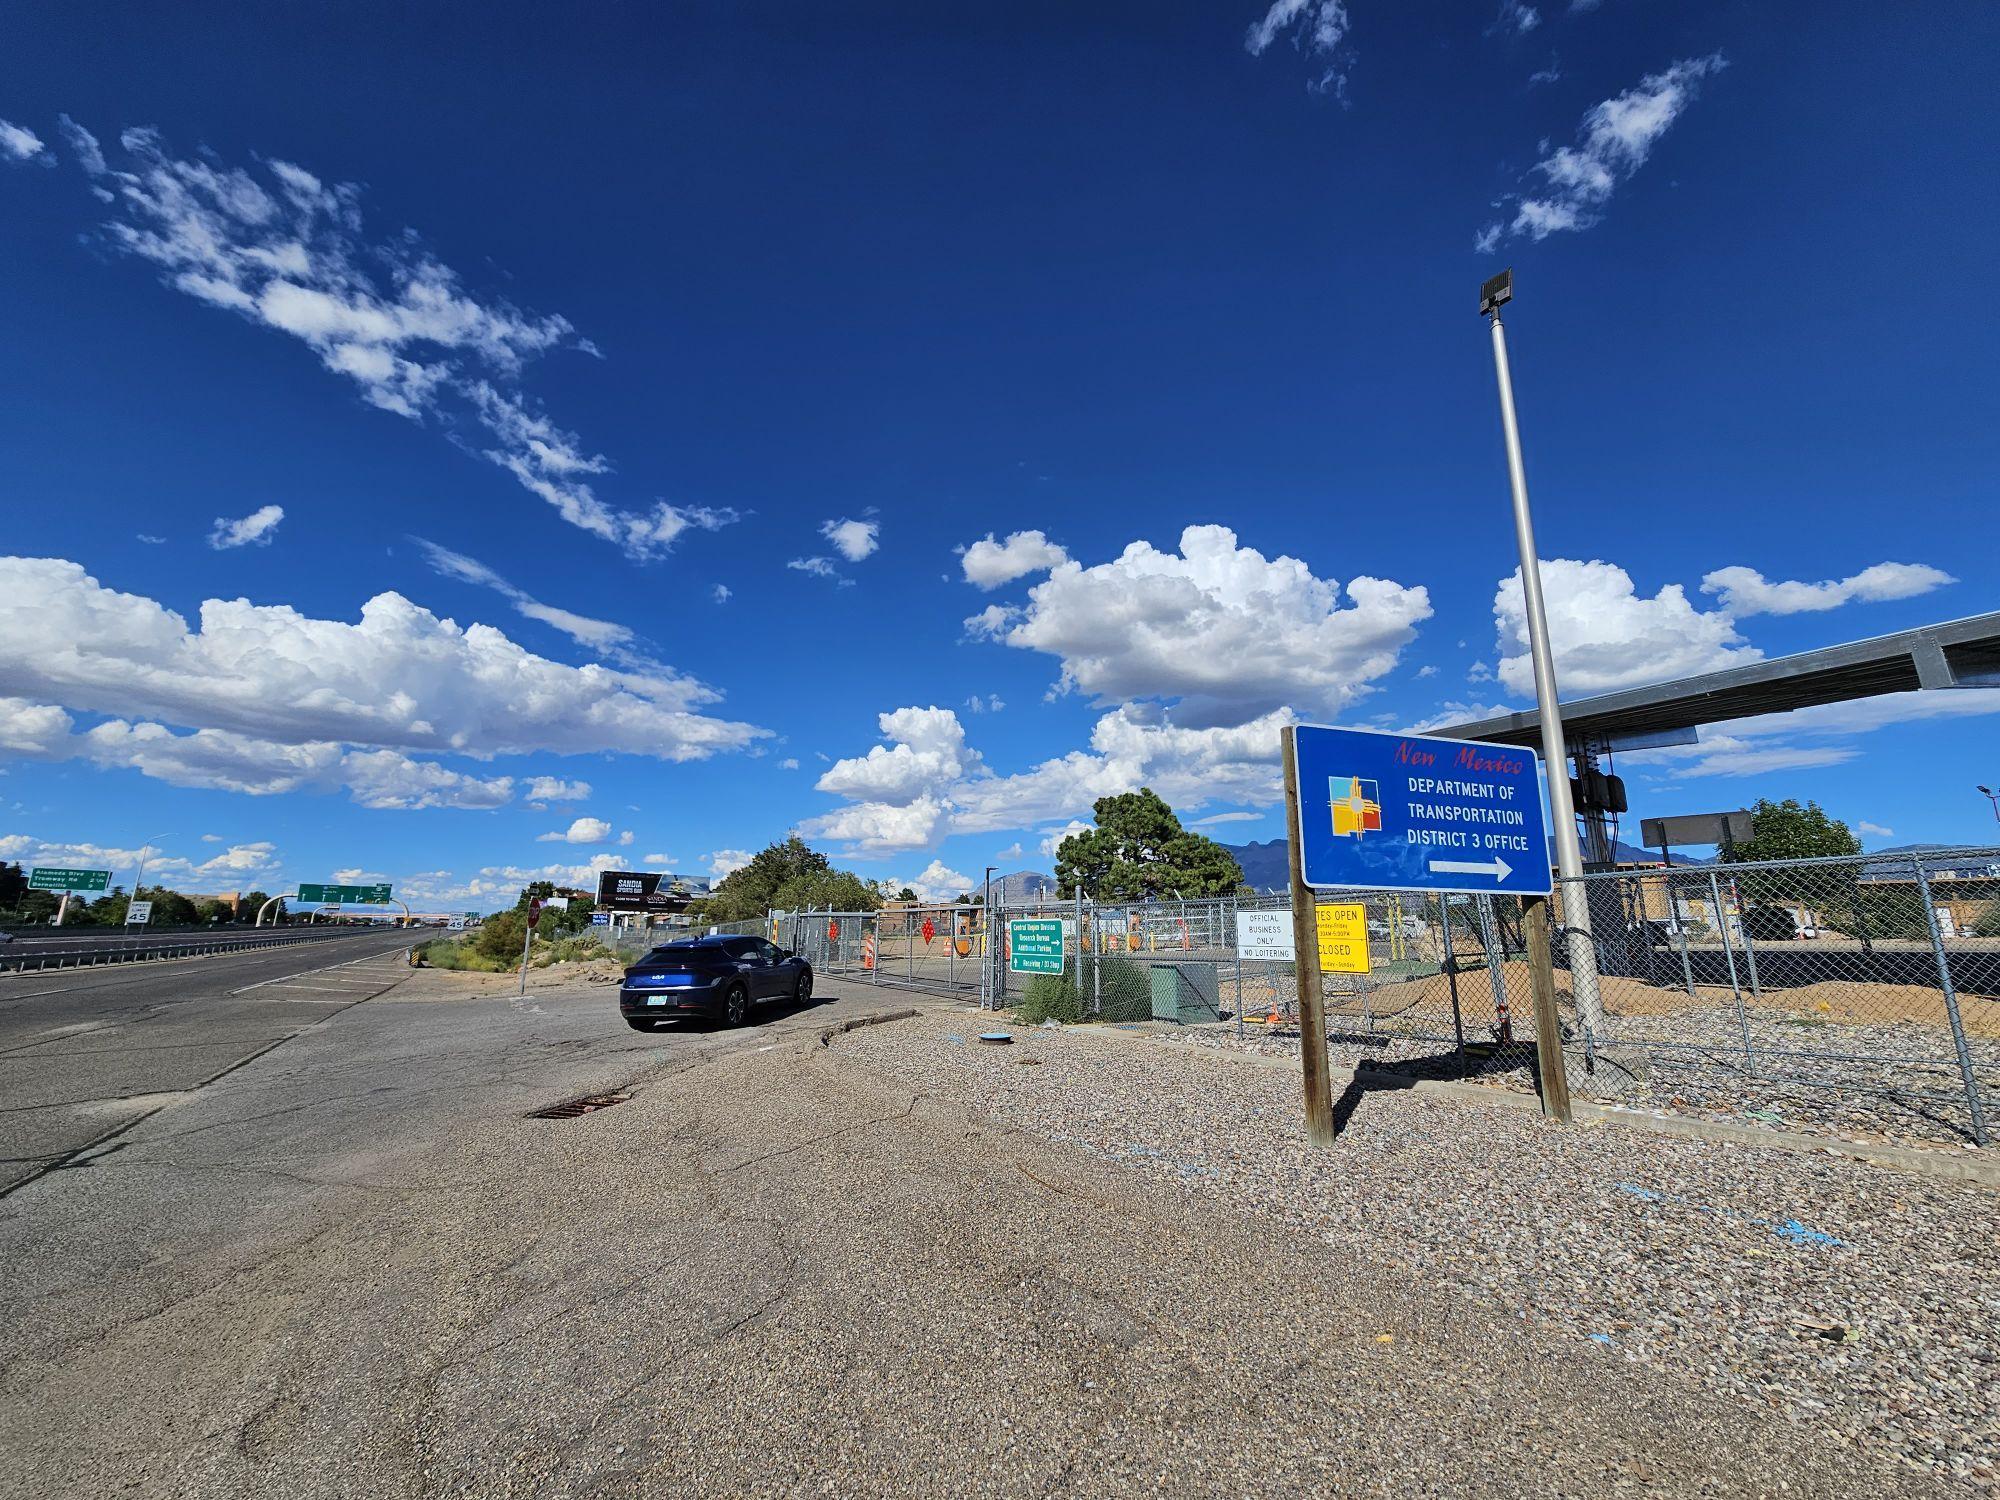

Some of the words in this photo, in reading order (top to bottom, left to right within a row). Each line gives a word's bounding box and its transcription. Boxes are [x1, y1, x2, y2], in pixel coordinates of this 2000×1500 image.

[1392, 740, 1436, 768] New
[1454, 746, 1523, 775] Mexico
[1408, 777, 1494, 799] DEPARTMENT
[1499, 785, 1515, 800] OF
[1407, 803, 1524, 826] TRANSPORTATION
[1407, 829, 1467, 847] DISTRICT
[1472, 833, 1480, 848] 3
[1484, 834, 1529, 851] OFFICE
[617, 879, 642, 888] SANDIA
[129, 913, 146, 921] 45
[1249, 914, 1279, 922] OFFICIAL
[1316, 910, 1331, 921] TES
[1335, 910, 1358, 921] OPEN
[1027, 924, 1039, 932] Region
[1248, 925, 1282, 934] BUSINESS
[1256, 937, 1274, 945] ONLY
[1037, 944, 1051, 954] Parking
[1244, 949, 1253, 957] NO
[1255, 949, 1290, 958] LOITERING
[1318, 945, 1351, 956] CLOSED
[1023, 960, 1040, 969] Receiving
[1050, 960, 1060, 970] Shop
